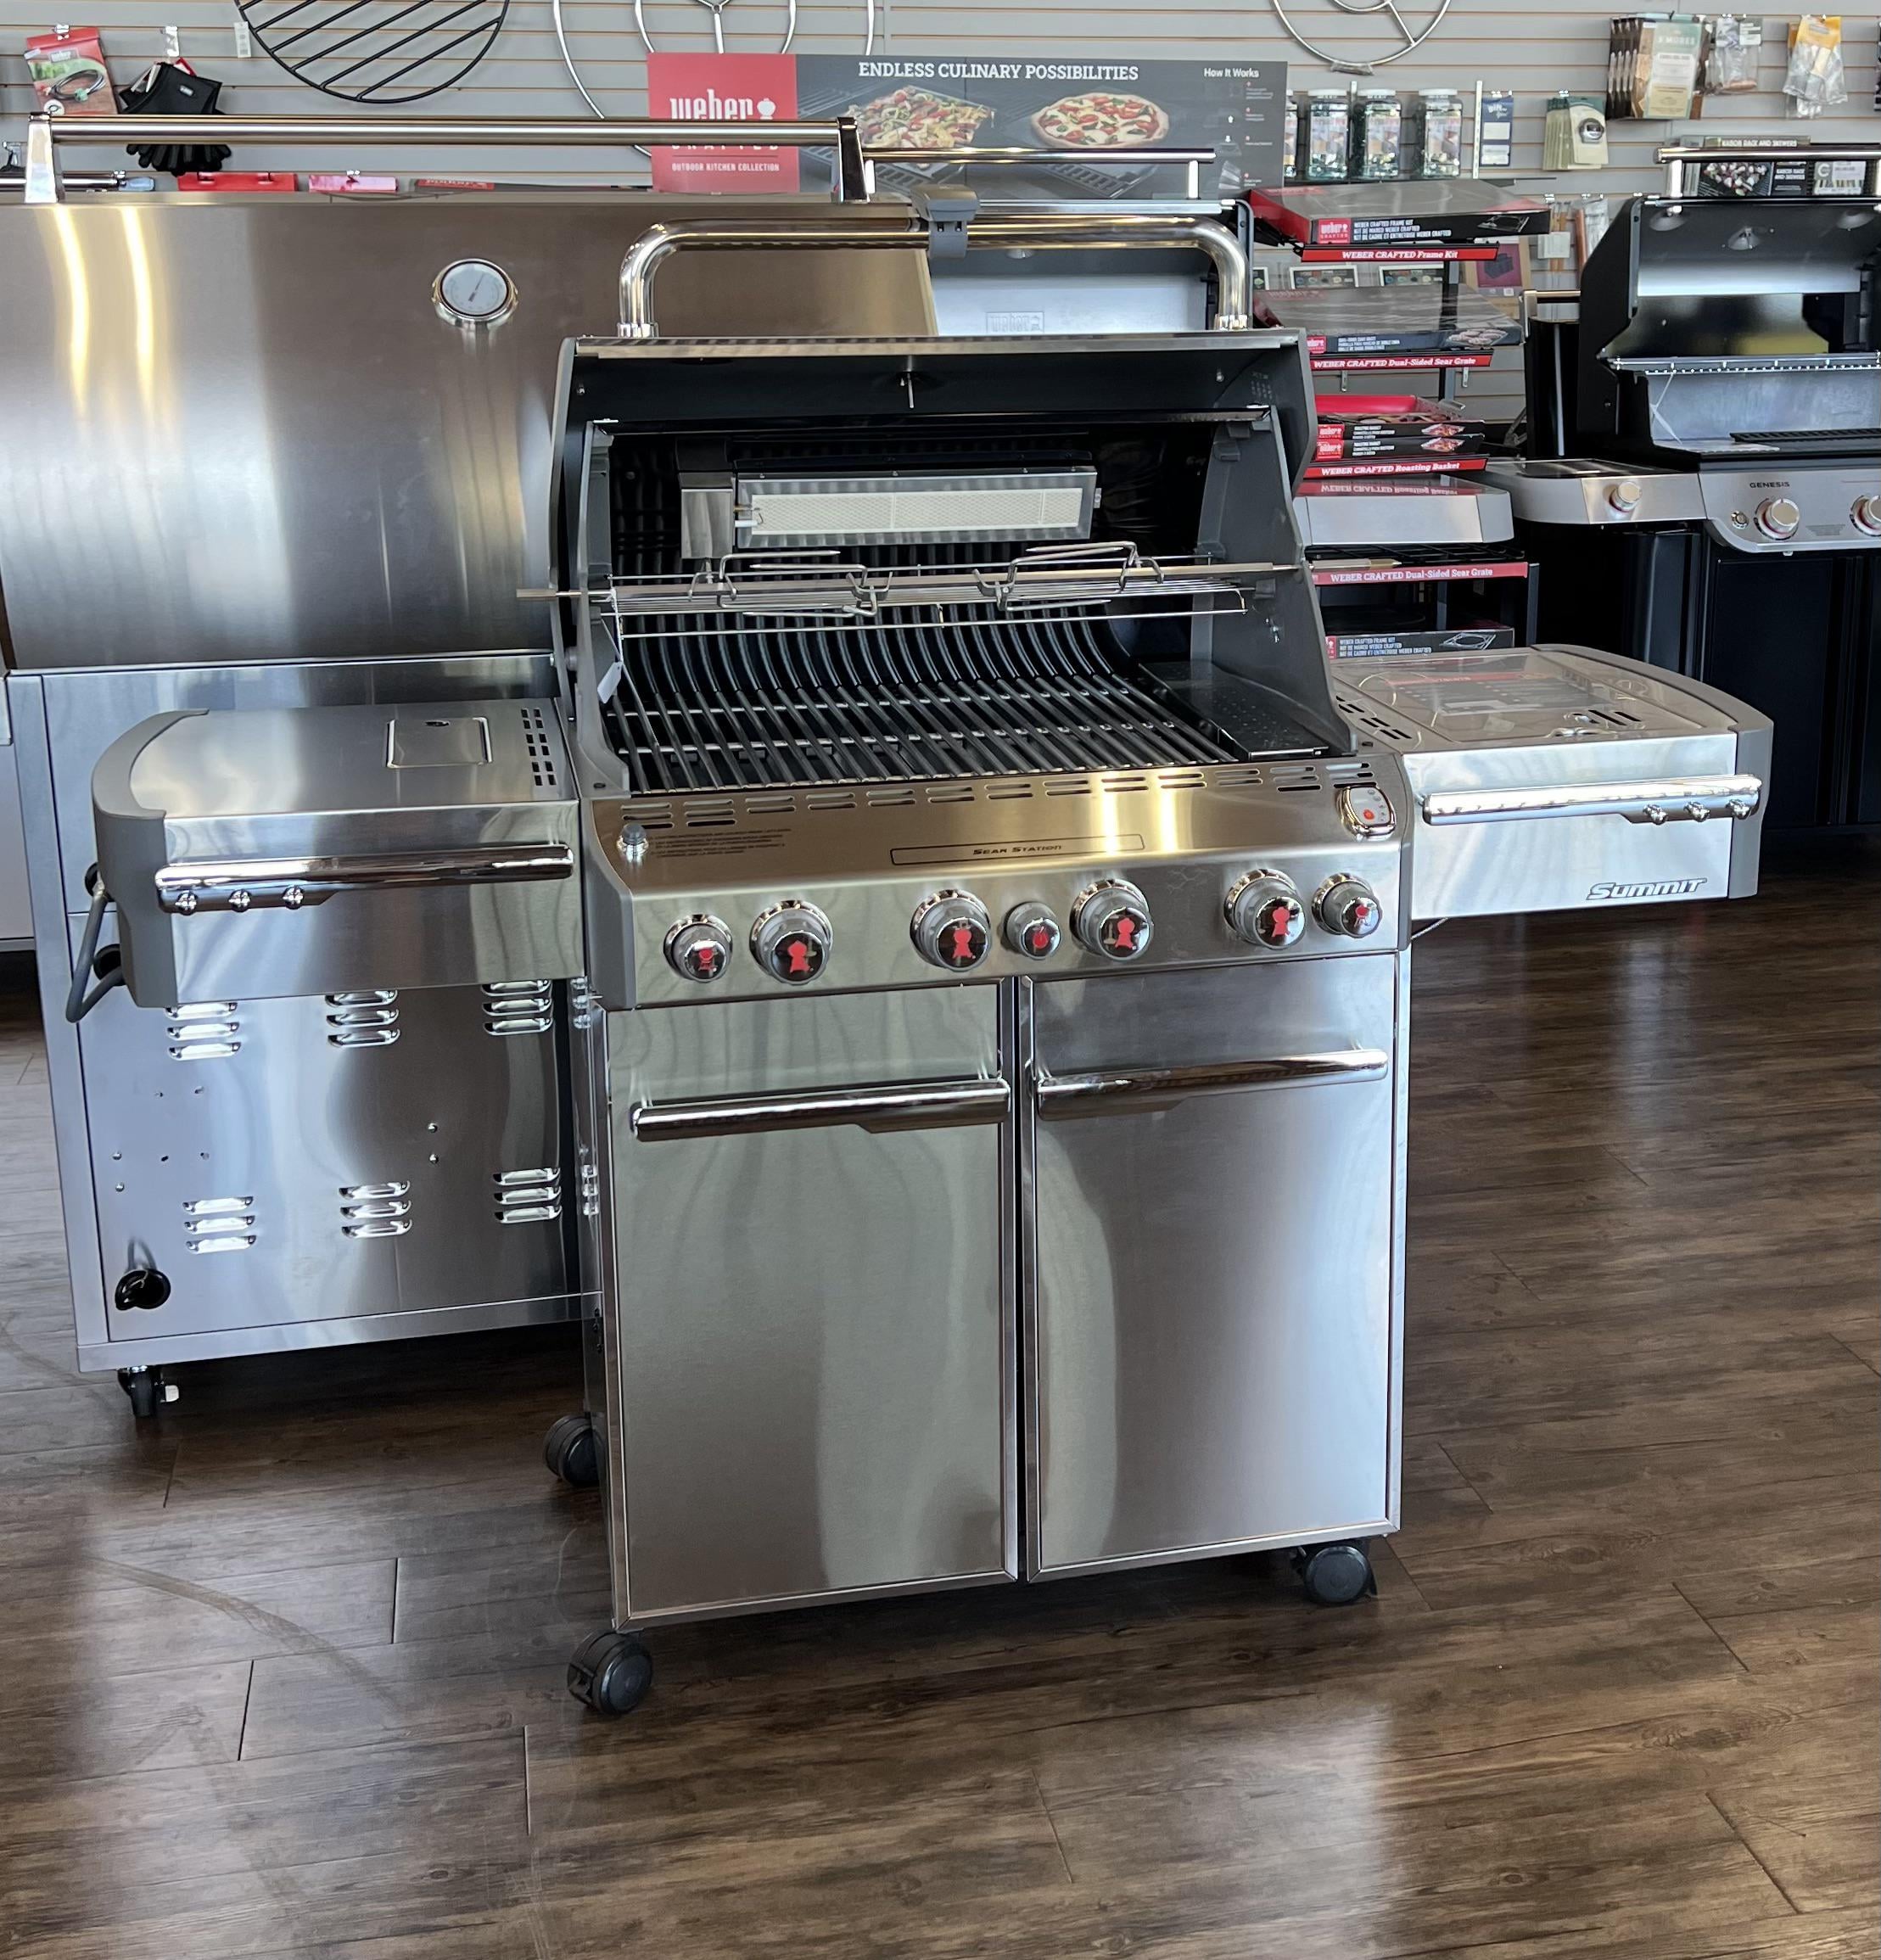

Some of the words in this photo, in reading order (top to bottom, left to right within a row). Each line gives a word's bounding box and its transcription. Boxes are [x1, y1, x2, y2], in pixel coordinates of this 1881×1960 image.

[859, 62, 935, 78] ENDLESS
[938, 64, 1022, 79] CULINARY
[1025, 65, 1139, 81] POSSIBILITIES
[1203, 68, 1223, 77] How
[1224, 69, 1232, 77] It
[1233, 68, 1260, 78] Works
[672, 163, 704, 171] OUTDOOR
[706, 163, 736, 171] KITCHEN
[737, 163, 780, 171] COLLECTION
[1374, 250, 1417, 259] CRAFTED
[1417, 250, 1444, 259] Frame
[1444, 250, 1458, 259] Kit
[1389, 358, 1433, 367] Dual-Sided
[1321, 468, 1353, 476] WEBER
[1354, 465, 1394, 474] CRAFTED
[1395, 463, 1431, 473] Roasting
[1330, 573, 1362, 582] WEBER
[1363, 572, 1404, 581] CRAFTED
[1405, 570, 1450, 580] Dual-Sided
[1451, 569, 1470, 578] Sear
[1471, 568, 1493, 577] Grate
